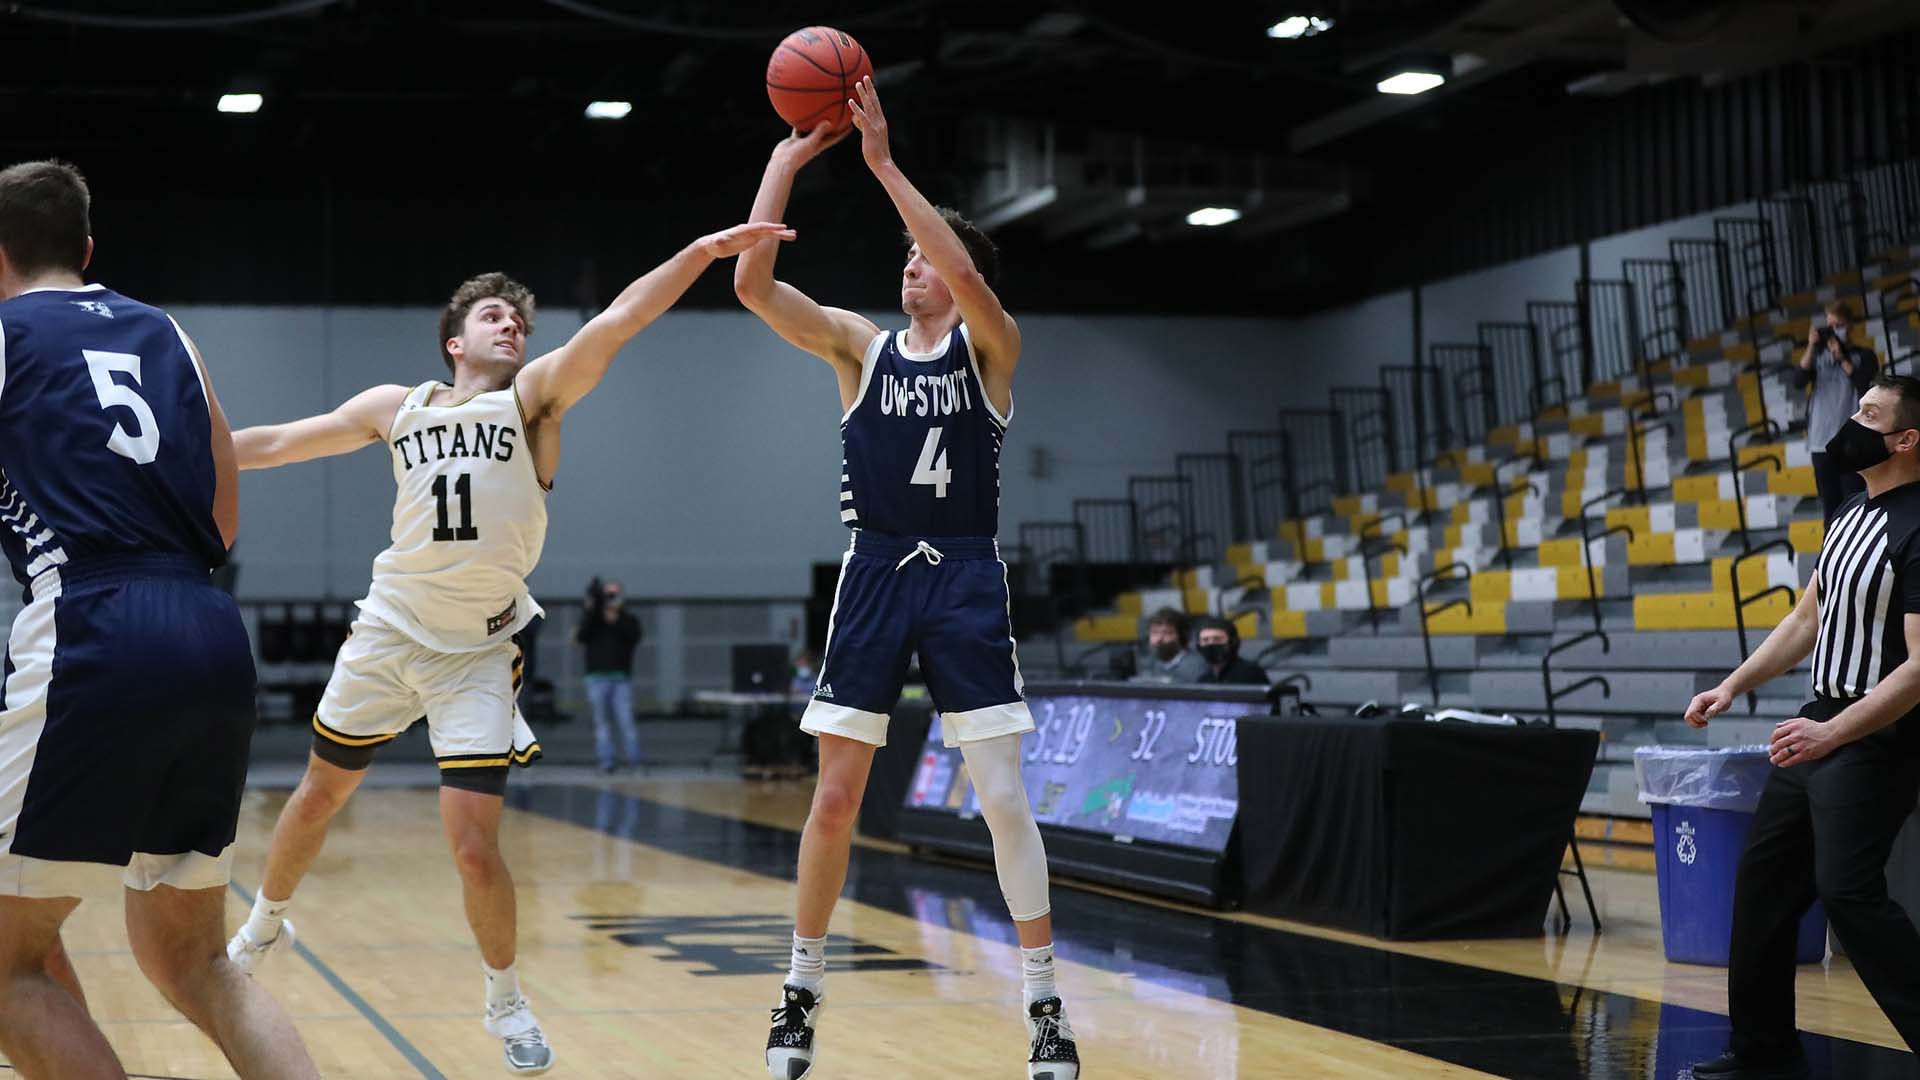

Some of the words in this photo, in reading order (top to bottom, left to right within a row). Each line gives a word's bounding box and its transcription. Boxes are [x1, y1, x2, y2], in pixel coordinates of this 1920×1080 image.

[82, 349, 160, 465] 5
[880, 366, 972, 417] UW-STOUT
[393, 422, 517, 470] TITANS
[909, 426, 952, 498] 4
[431, 473, 478, 542] 11
[1130, 709, 1166, 760] 32
